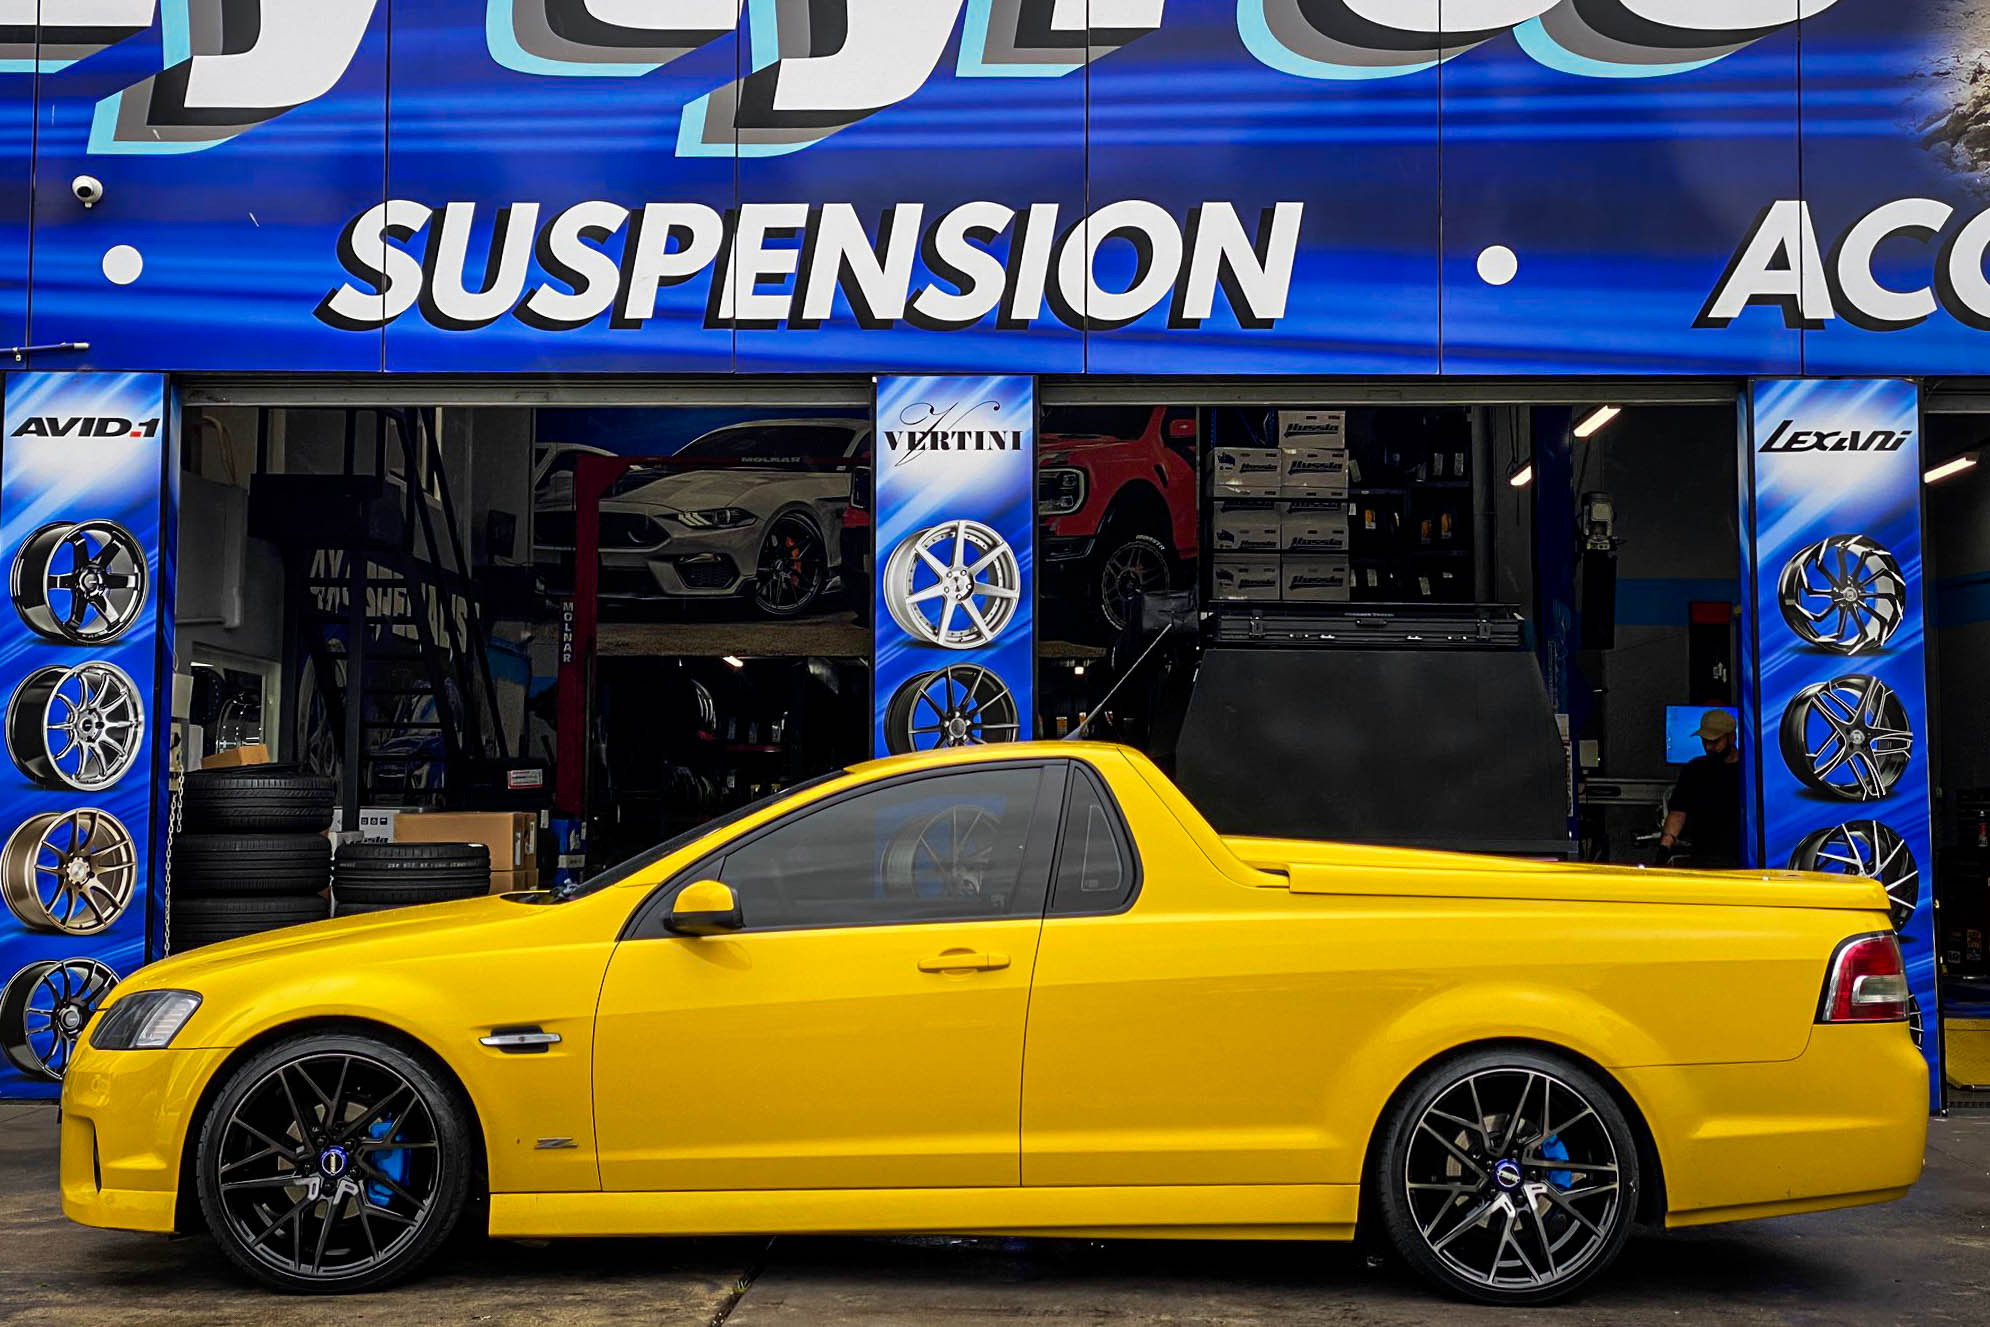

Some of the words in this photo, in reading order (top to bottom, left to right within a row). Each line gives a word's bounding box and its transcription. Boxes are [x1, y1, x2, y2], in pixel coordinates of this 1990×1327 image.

[316, 200, 1304, 329] SUSPENSION
[10, 416, 161, 438] AVID.1
[883, 430, 1024, 451] VERTINI
[562, 601, 574, 664] MOLNAR
